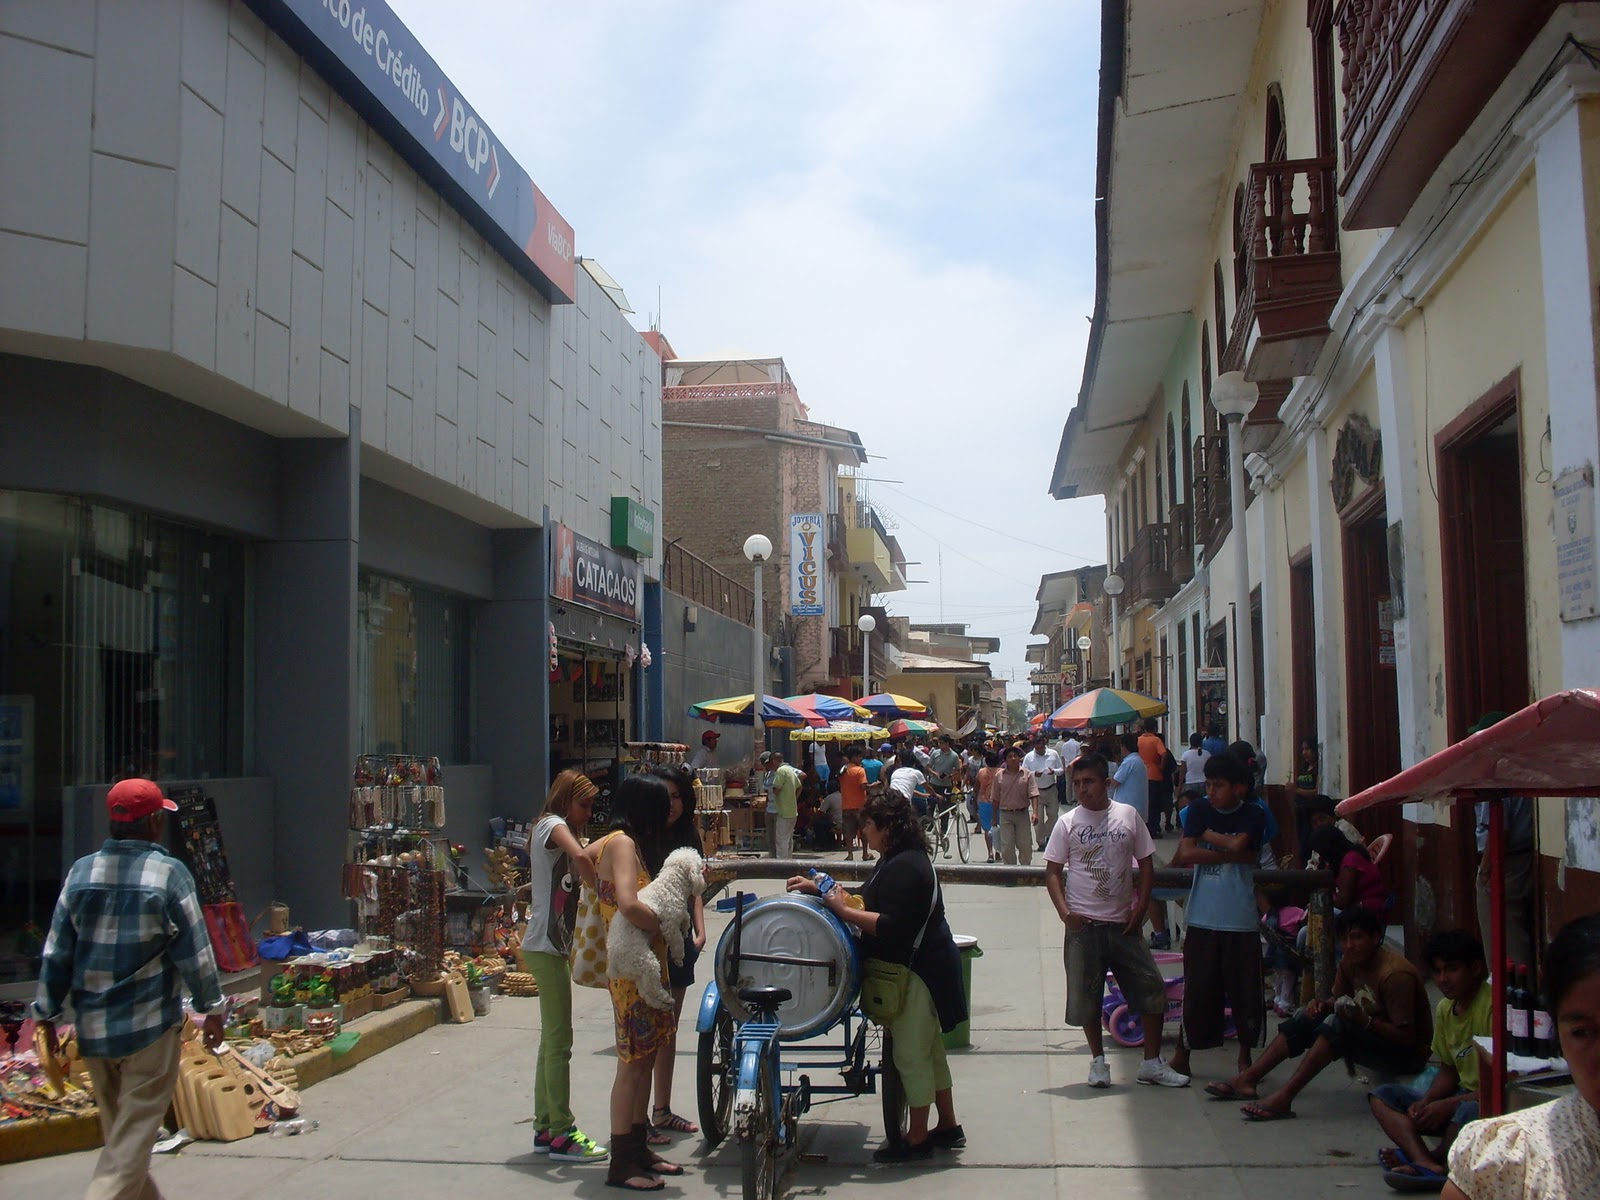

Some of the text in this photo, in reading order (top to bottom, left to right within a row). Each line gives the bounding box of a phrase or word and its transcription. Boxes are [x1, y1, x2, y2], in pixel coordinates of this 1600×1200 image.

[323, 0, 429, 117] co de Crédito
[450, 96, 489, 175] BCP
[791, 515, 821, 529] JOYERIA
[576, 556, 635, 606] CATACAOS
[798, 531, 818, 605] VICUS
